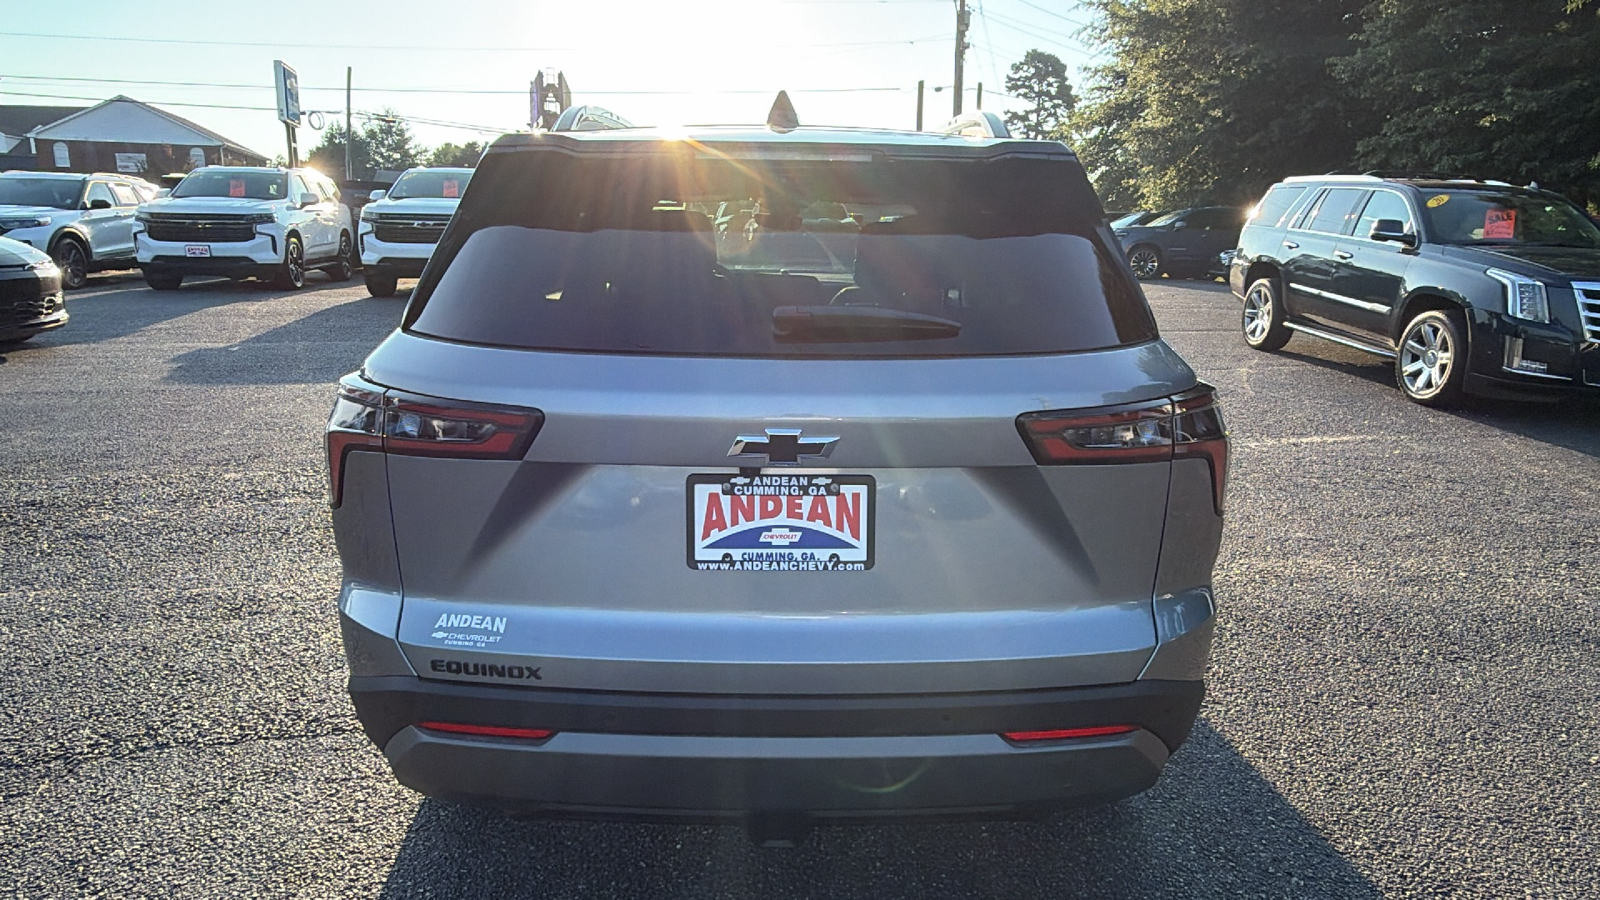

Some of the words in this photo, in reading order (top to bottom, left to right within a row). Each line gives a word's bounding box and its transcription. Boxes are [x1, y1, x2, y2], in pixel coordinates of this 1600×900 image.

[1487, 212, 1513, 224] SALE
[752, 476, 809, 486] ANDEAN
[733, 486, 803, 496] CUMMING,
[808, 487, 828, 496] GA
[701, 492, 861, 542] ANDEAN
[741, 552, 799, 562] CUMMING,
[801, 552, 821, 561] GA.
[697, 561, 865, 571] www.ANDEANCHEVY.com
[434, 613, 507, 634] ANDEAN
[448, 632, 502, 643] CHEVROLET
[430, 659, 542, 680] EQUINOX
